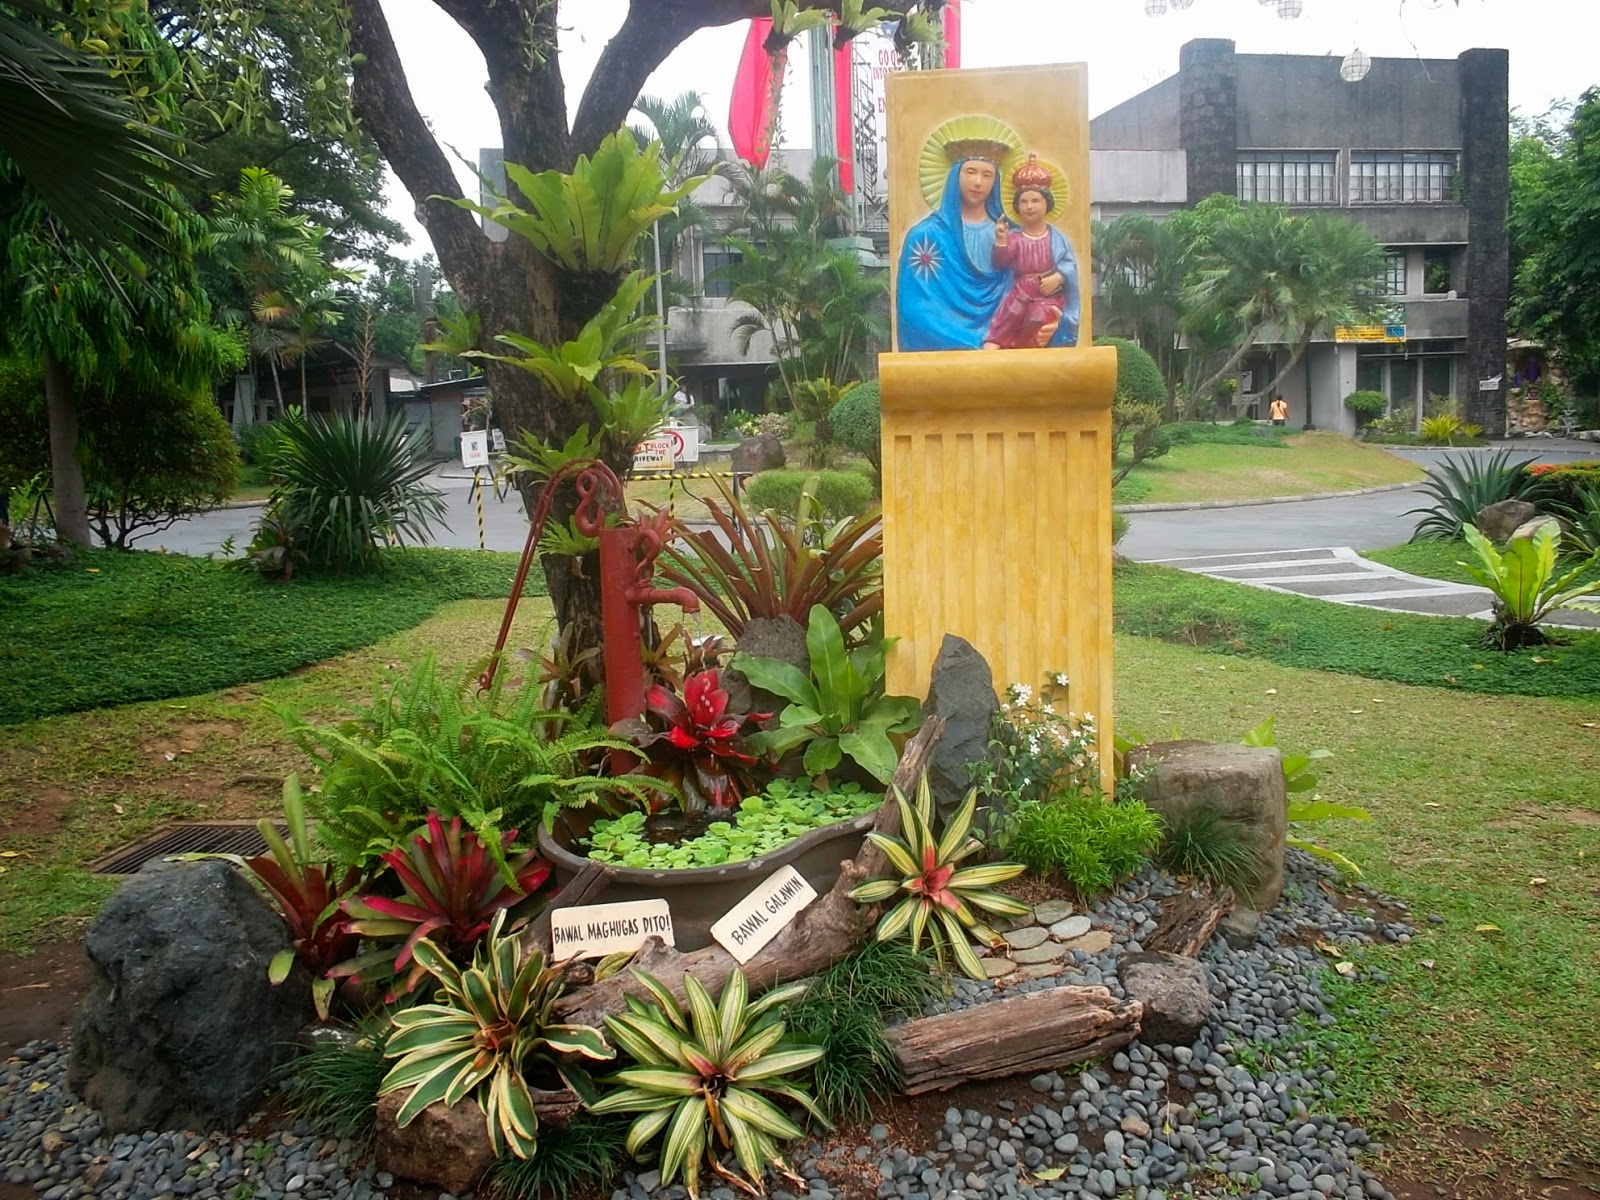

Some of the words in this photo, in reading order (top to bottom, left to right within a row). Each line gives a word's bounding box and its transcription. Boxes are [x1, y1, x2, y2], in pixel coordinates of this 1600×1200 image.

[878, 49, 889, 66] GO
[731, 908, 769, 946] BAWAL
[765, 875, 804, 914] GALAWIN
[553, 926, 584, 944] BAWAL
[587, 917, 639, 940] MAGHUGAS
[642, 914, 671, 934] DITO!
